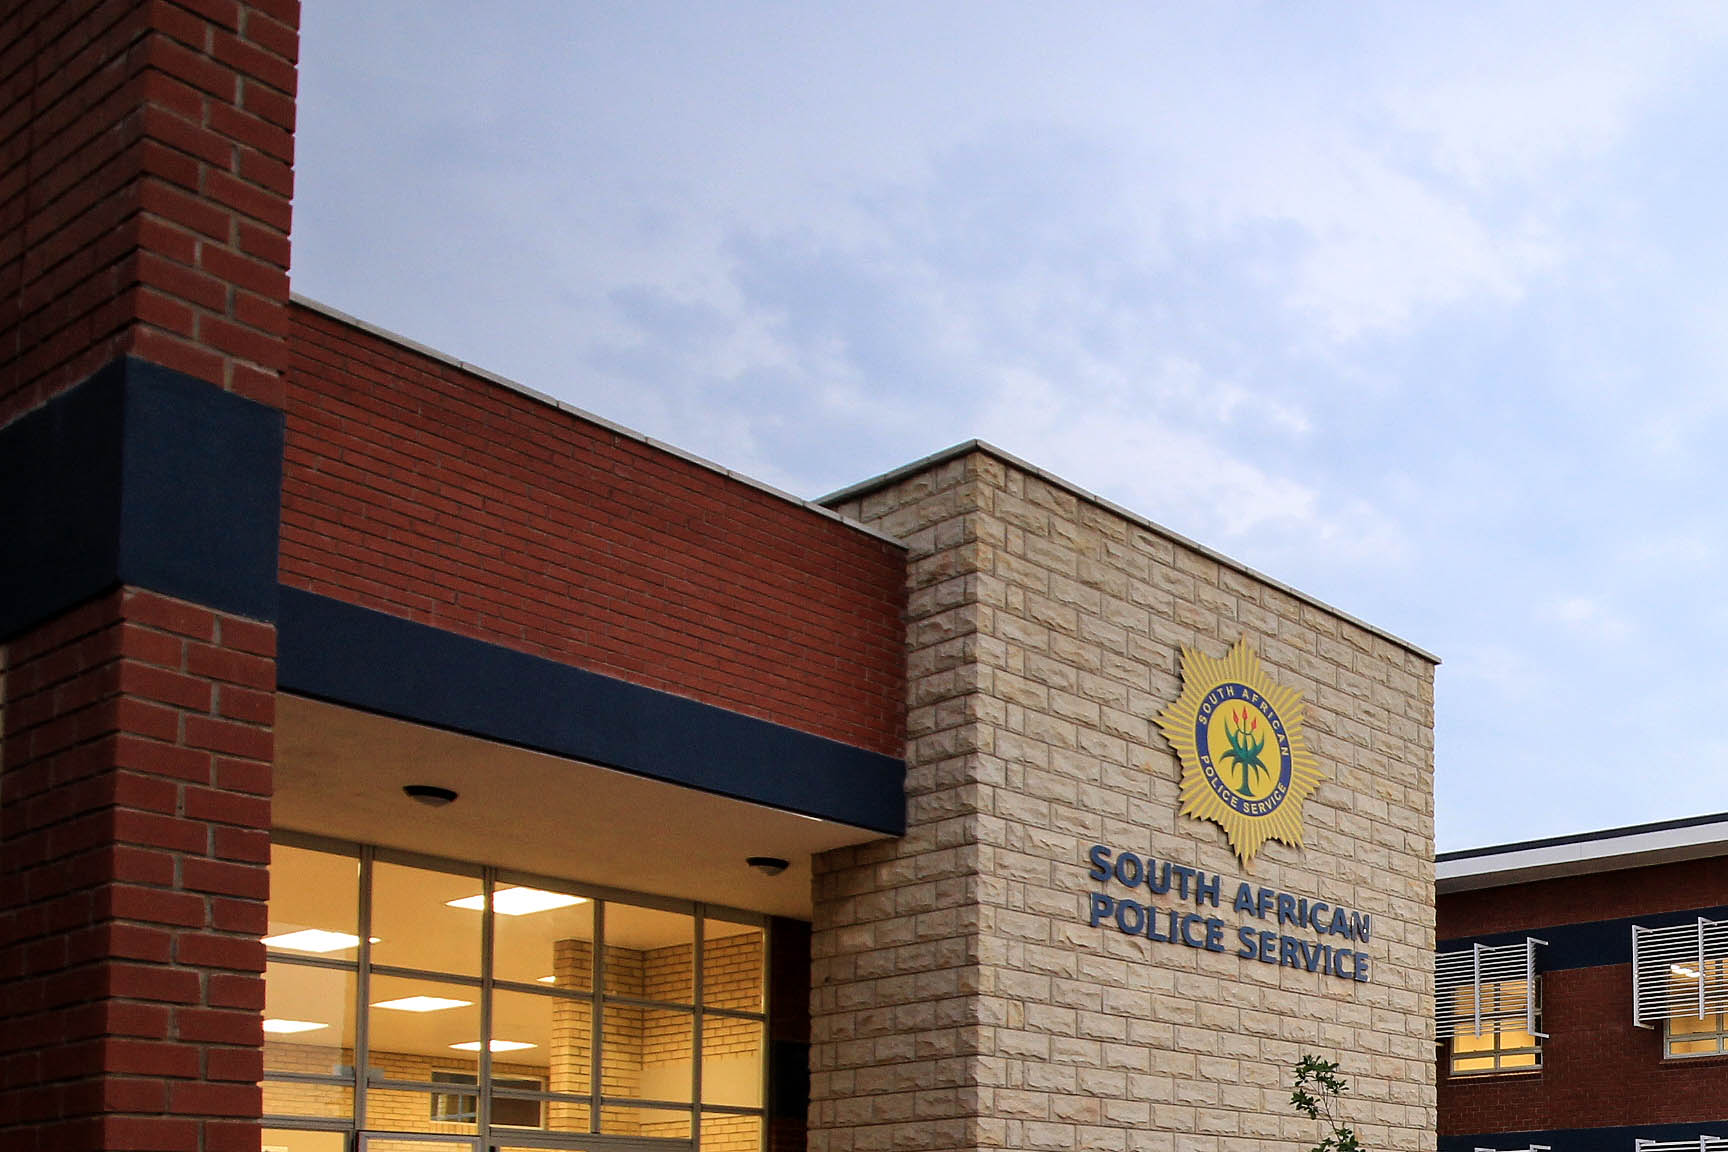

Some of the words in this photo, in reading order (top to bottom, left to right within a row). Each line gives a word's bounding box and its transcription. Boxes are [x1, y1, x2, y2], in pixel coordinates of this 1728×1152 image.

[1198, 686, 1235, 725] SOUTH
[1241, 688, 1289, 756] AFRICAN
[1200, 755, 1238, 808] POLICE
[1242, 782, 1287, 814] SERVICE
[1090, 844, 1220, 908] SOUTH
[1234, 882, 1370, 943] AFRICAN
[1090, 892, 1225, 952] POLICE
[1239, 926, 1370, 983] SERVICE
